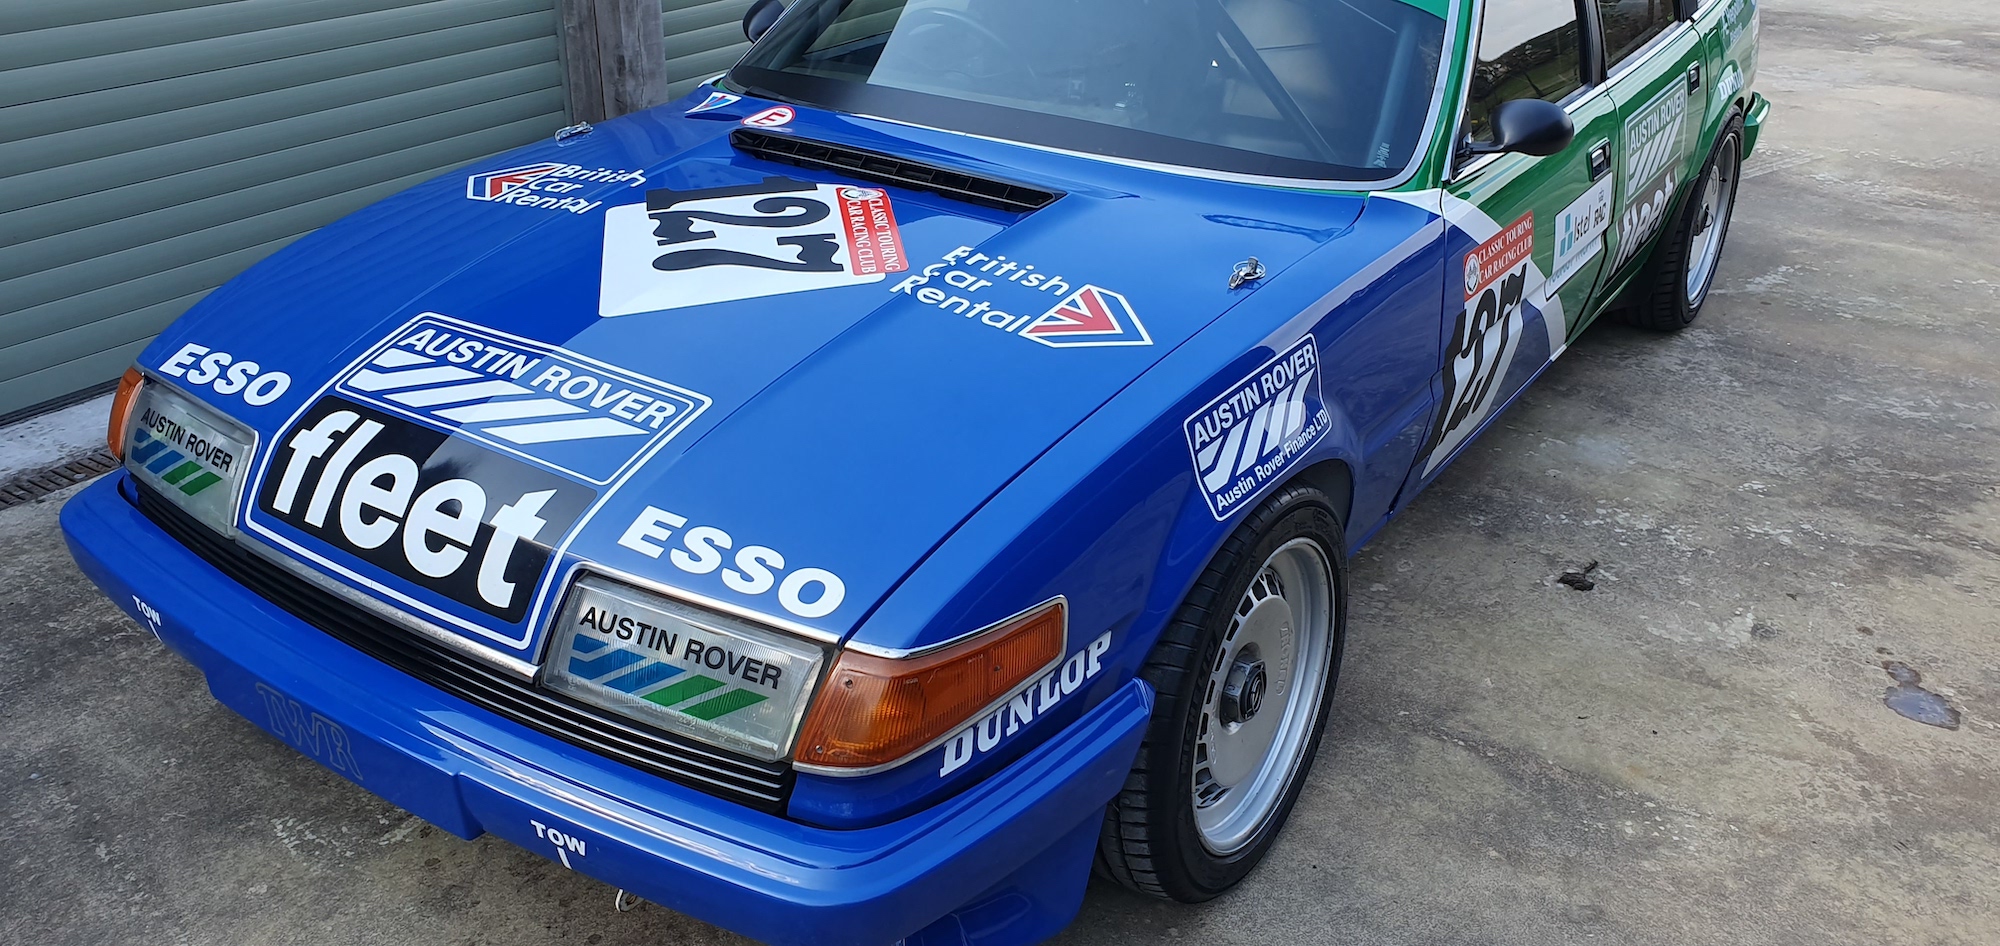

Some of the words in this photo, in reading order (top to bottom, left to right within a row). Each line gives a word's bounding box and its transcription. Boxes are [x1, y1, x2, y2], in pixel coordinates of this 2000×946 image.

[752, 111, 787, 125] E
[1630, 106, 1660, 154] AUSTIN
[1659, 87, 1685, 125] ROVER
[494, 188, 603, 215] Rental
[528, 178, 584, 194] Car
[550, 164, 647, 188] British
[645, 176, 844, 273] 127
[846, 200, 864, 217] CAR
[850, 216, 872, 248] RACING
[868, 198, 890, 230] CLASSIC
[1609, 171, 1674, 277] fleet
[857, 248, 877, 274] CLUB
[876, 230, 901, 271] TOURING
[1479, 235, 1505, 264] CLASSIC
[1505, 216, 1532, 245] TOURING
[1479, 264, 1493, 284] CAR
[1493, 246, 1517, 274] RACING
[1516, 235, 1533, 256] CLUB
[922, 263, 993, 292] Car
[941, 246, 1071, 297] British
[889, 275, 1031, 333] Rental
[158, 342, 292, 406] ESSO
[397, 327, 541, 380] AUSTIN
[530, 363, 677, 431] ROVER
[1194, 381, 1261, 451] AUSTIN
[1260, 343, 1316, 399] ROVER
[140, 407, 186, 445] AUSTIN
[185, 434, 233, 473] ROVER
[1216, 475, 1257, 512] Austin
[1254, 452, 1285, 482] Rover
[1283, 424, 1317, 459] Finance
[1313, 408, 1328, 432] LTD
[271, 409, 557, 609] fleet
[617, 504, 847, 619] ESSO
[132, 595, 162, 627] TOW
[579, 606, 678, 655] AUSTIN
[683, 638, 782, 690] ROVER
[939, 630, 1112, 778] DUNLOP
[255, 682, 364, 781] TWR
[530, 819, 587, 857] TOW
